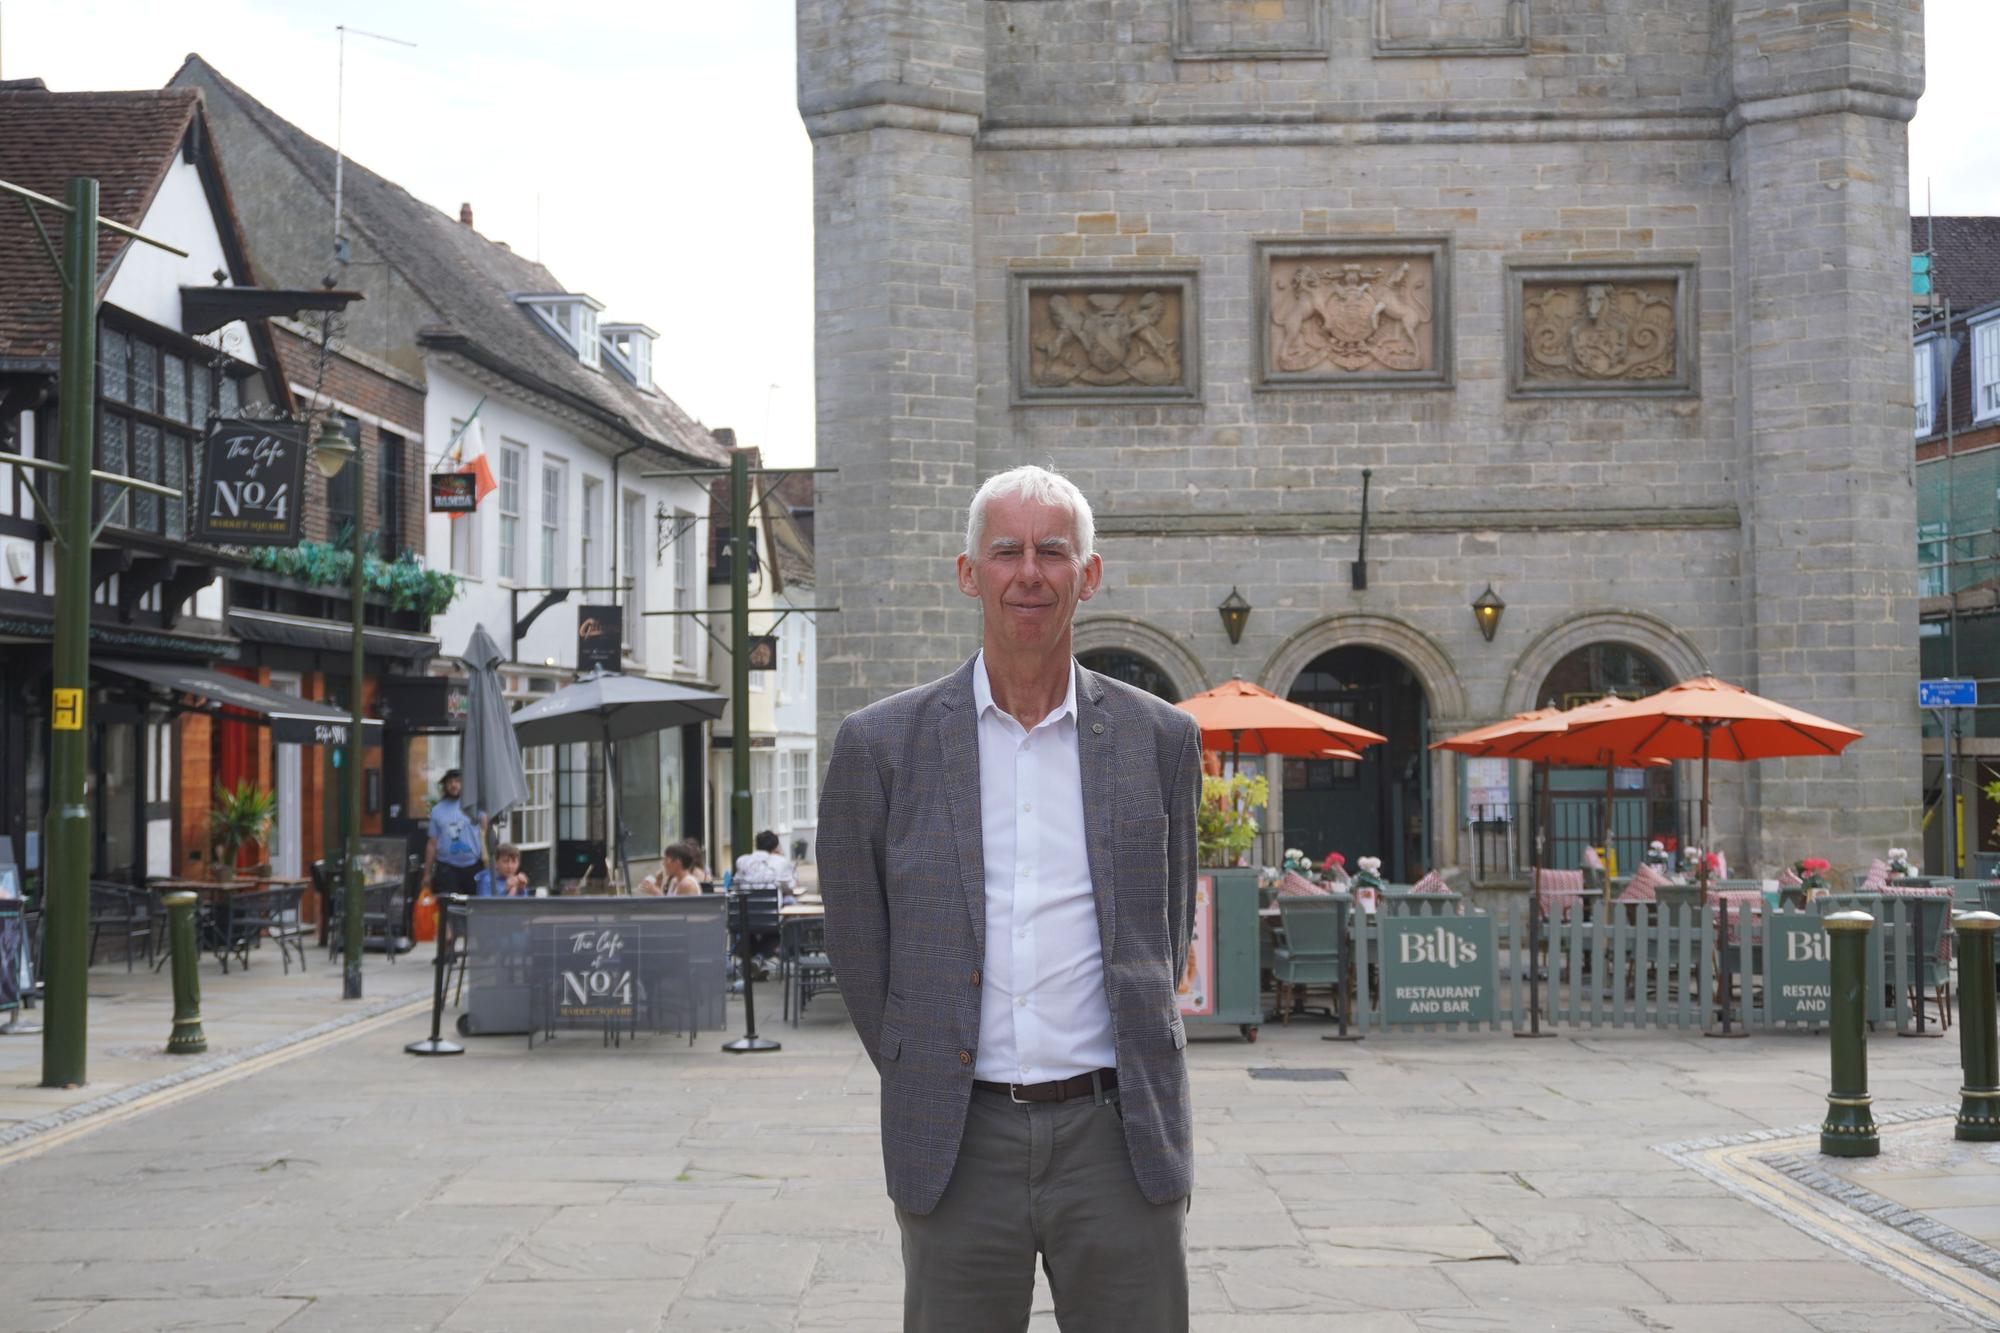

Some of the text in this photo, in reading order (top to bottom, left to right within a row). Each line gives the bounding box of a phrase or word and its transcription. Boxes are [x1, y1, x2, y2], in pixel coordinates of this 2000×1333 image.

[225, 436, 285, 467] The Cafe
[246, 463, 260, 478] at
[209, 519, 286, 532] MARKET SQUARE
[54, 693, 77, 724] H
[570, 931, 624, 958] The Cafe
[1400, 926, 1477, 969] Bill's
[1787, 930, 1831, 961] Bil
[1396, 985, 1481, 999] RESTAURANT
[1783, 984, 1831, 997] RESTAU
[560, 1007, 632, 1017] MARKET SQUARE
[1410, 1001, 1470, 1013] AND BAR
[1796, 999, 1827, 1011] AND
